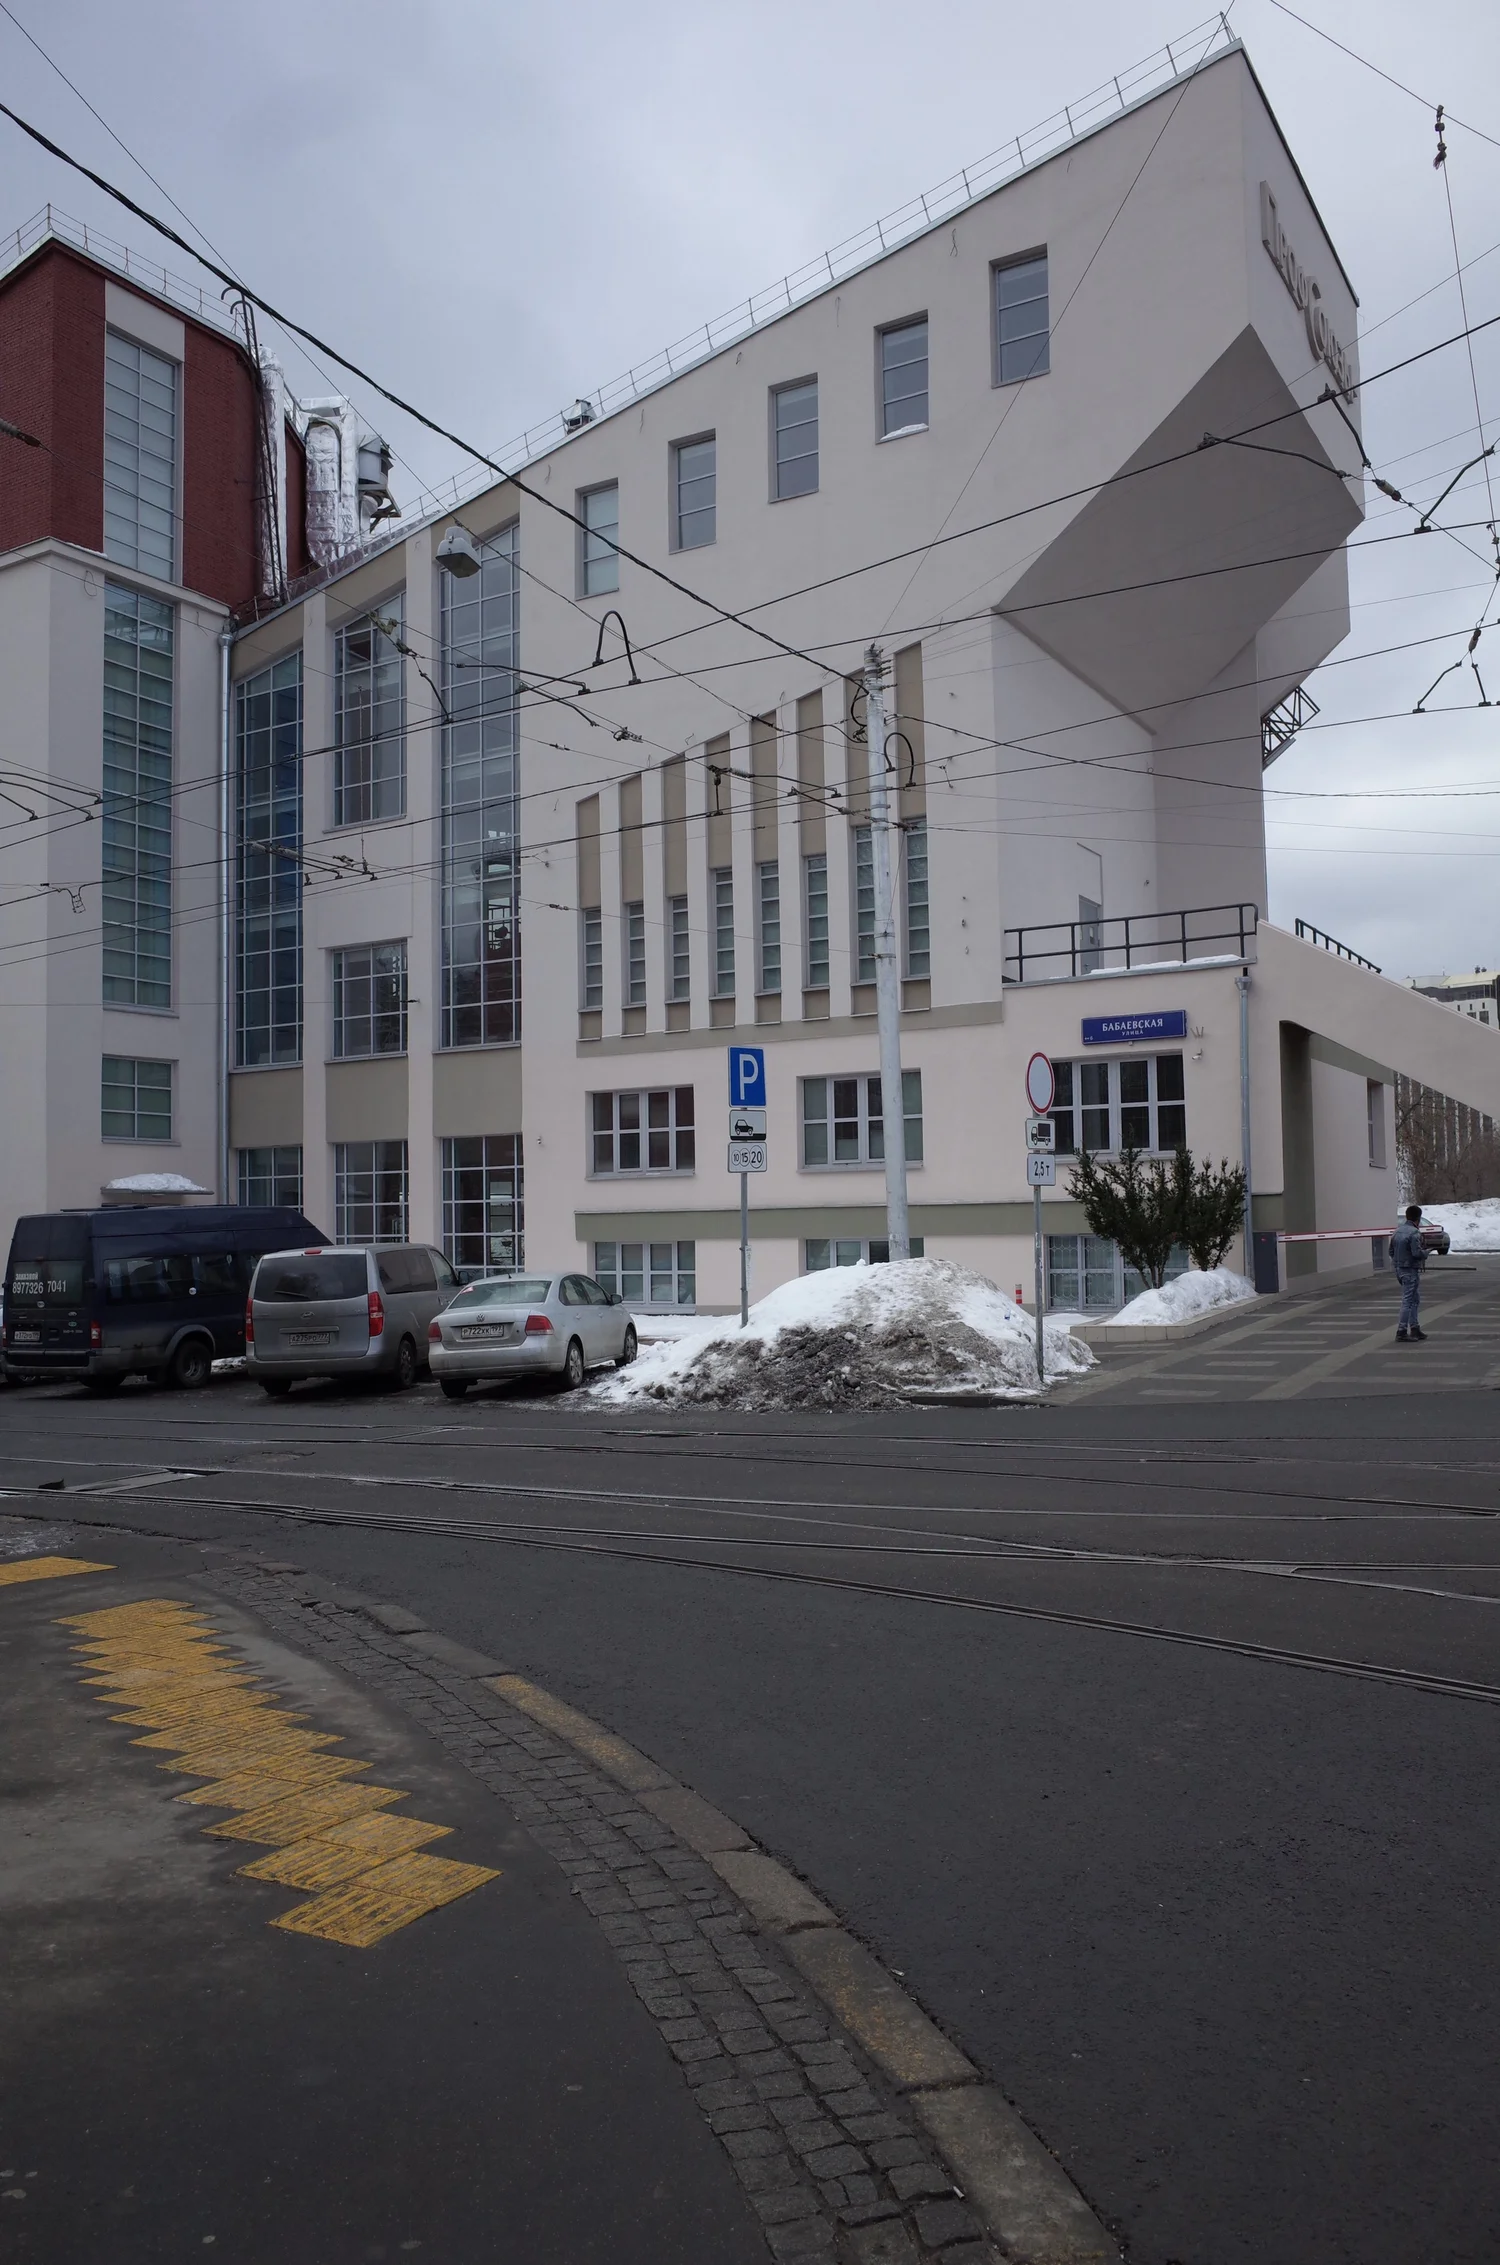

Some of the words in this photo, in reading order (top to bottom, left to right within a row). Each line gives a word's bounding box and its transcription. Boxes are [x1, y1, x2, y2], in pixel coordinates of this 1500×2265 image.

[1102, 1018, 1163, 1032] БАБАЕВСКАЯ
[739, 1053, 759, 1100] P
[733, 1153, 740, 1162] 10
[741, 1153, 749, 1163] 15
[751, 1151, 763, 1164] 20
[1034, 1160, 1045, 1179] 2,5
[12, 1281, 44, 1294] 8977326
[47, 1280, 67, 1293] 7041
